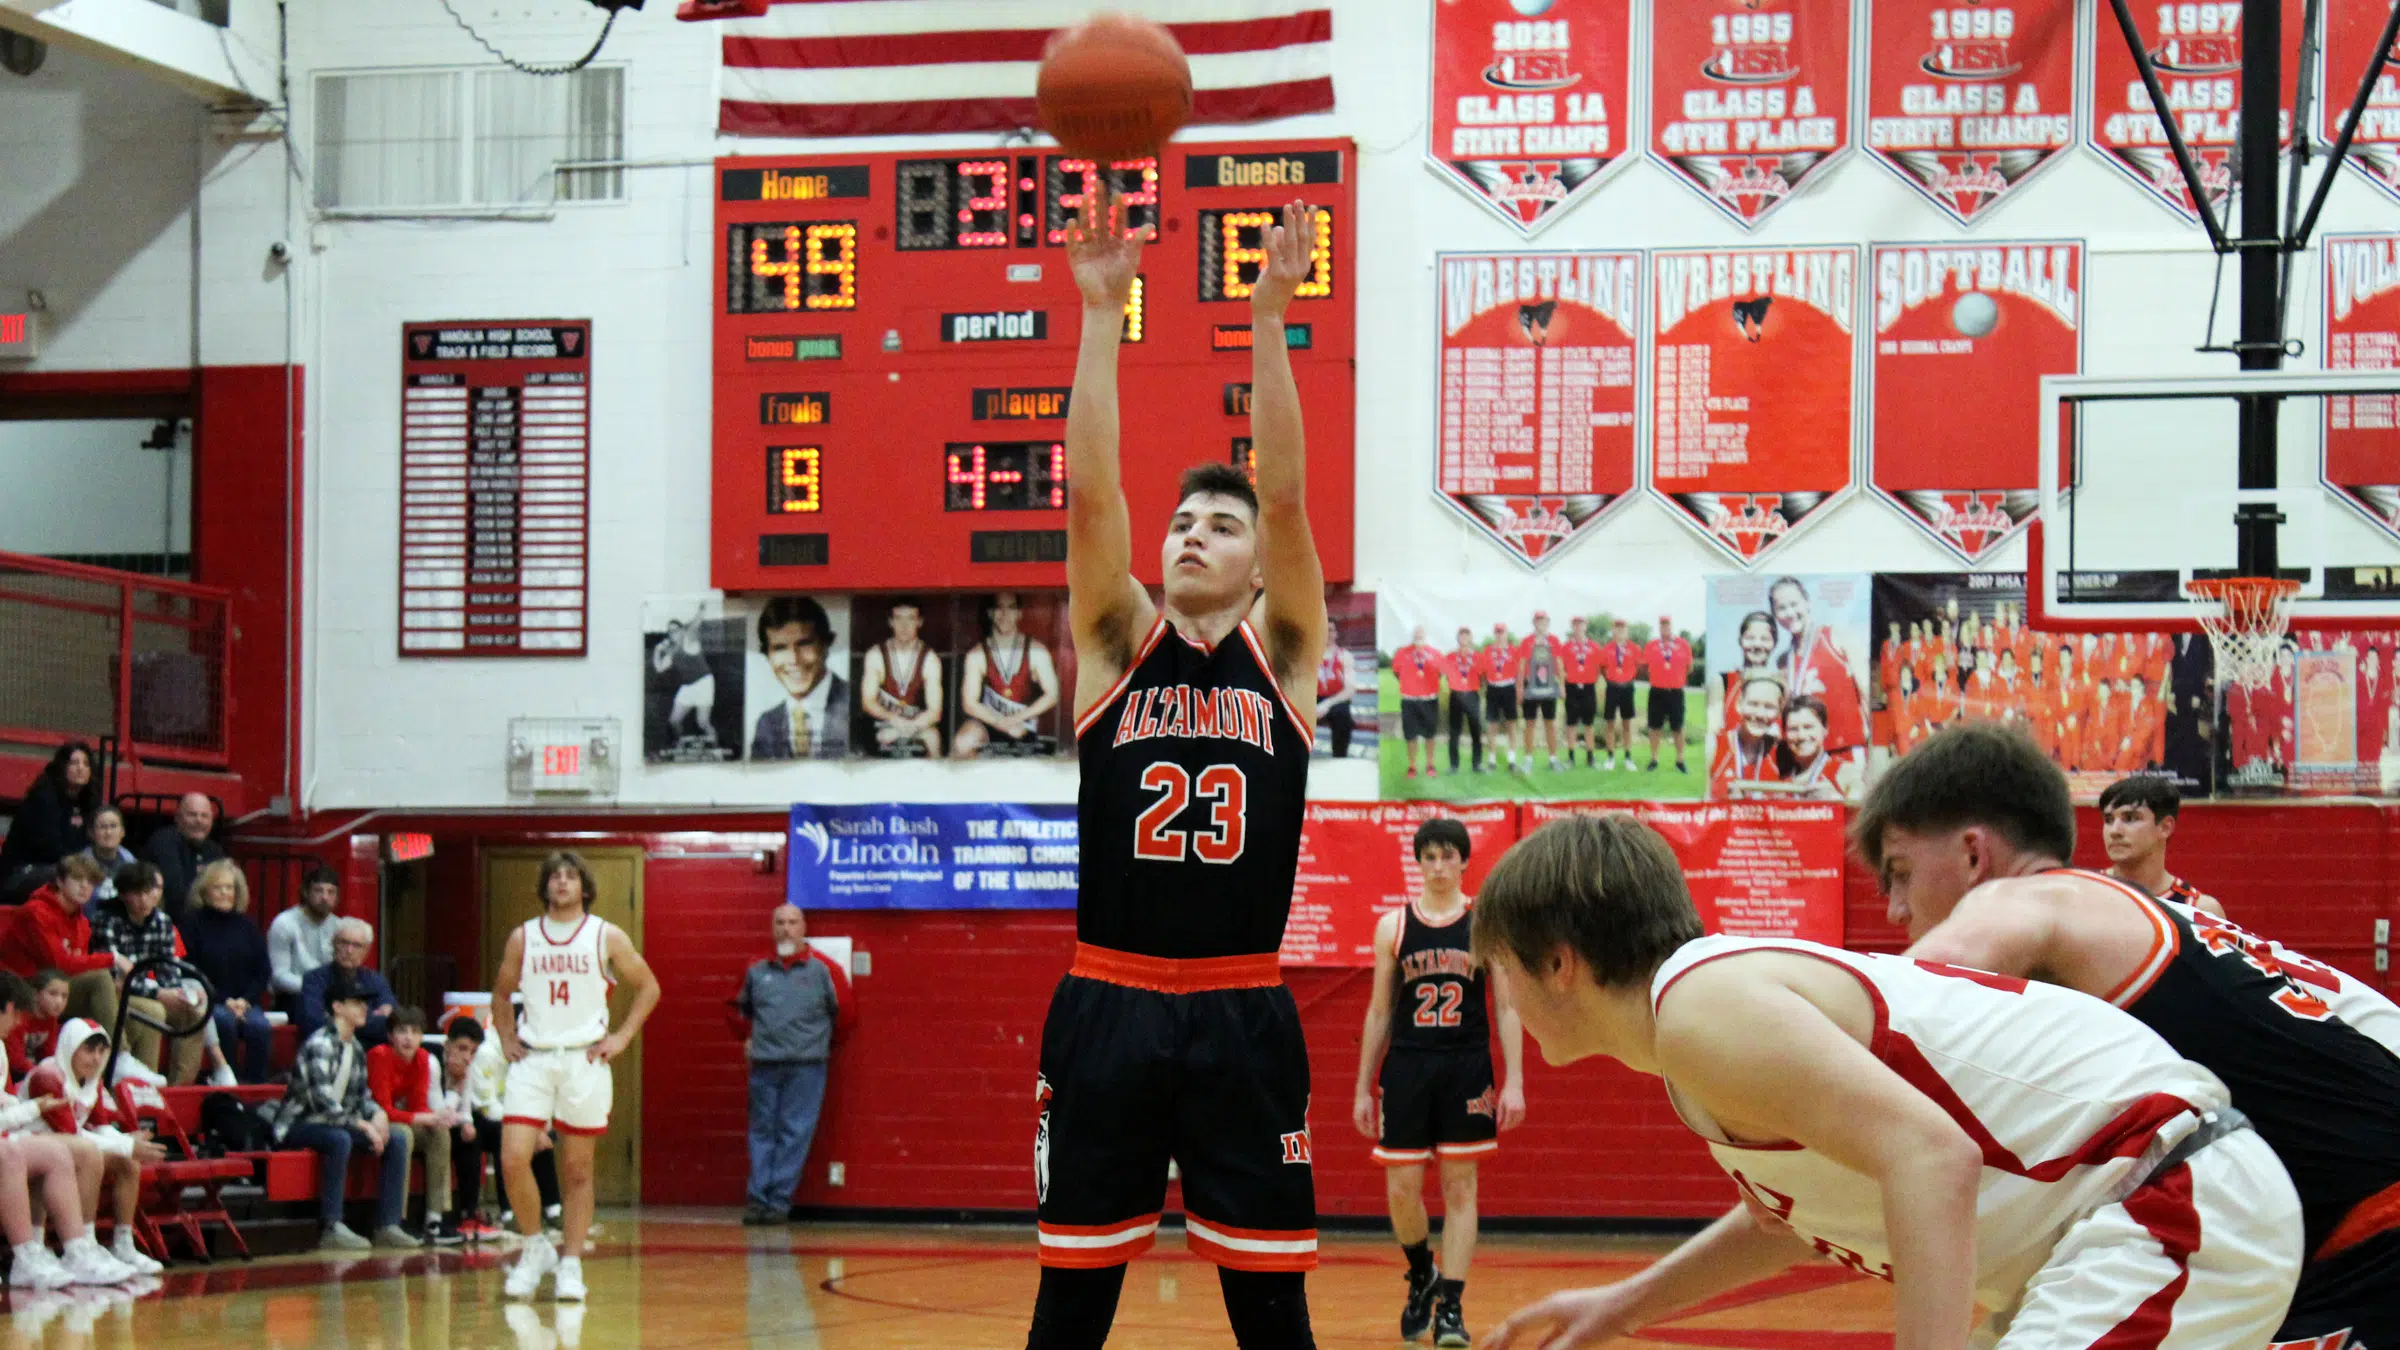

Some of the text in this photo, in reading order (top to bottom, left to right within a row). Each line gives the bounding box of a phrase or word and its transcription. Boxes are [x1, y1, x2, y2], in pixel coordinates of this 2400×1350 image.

[1711, 12, 1794, 46] 1995
[1930, 8, 2014, 40] 1996
[2157, 2, 2242, 34] 1997
[1492, 20, 1570, 51] 2021
[1456, 92, 1608, 125] CLASS 1A
[1682, 84, 1817, 121] CLASS A
[1901, 82, 2041, 115] CLASS A
[1452, 125, 1609, 156] STATE CHAMPS
[1661, 117, 1838, 153] 4TH PLACE
[1869, 113, 2072, 148] STATE CHAMPS
[761, 171, 829, 200] Home
[1217, 156, 1306, 186] Guests
[752, 224, 856, 309] 49
[1445, 257, 1636, 339] WRESTLING
[1658, 253, 1852, 335] WRESTLING
[1877, 247, 2077, 334] SOFTBALL
[0, 313, 27, 344] XIT
[515, 327, 555, 342] SCHOOL
[953, 310, 1035, 343] period
[1213, 327, 1253, 347] bonu
[435, 345, 468, 359] TRACK
[479, 345, 509, 358] FIELD
[511, 343, 558, 358] RECORDS
[748, 338, 795, 358] bonus
[767, 396, 823, 424] fouls
[986, 387, 1065, 421] player
[782, 447, 820, 512] 9
[1112, 684, 1275, 756] ALTAMONT
[543, 745, 581, 776] EXIT
[829, 815, 940, 836] Sarah Bush
[1134, 761, 1247, 866] 23
[966, 819, 1079, 840] THE ATHLETIC
[830, 836, 940, 866] Lincoln
[952, 844, 1079, 866] TRAINING CHOIC
[952, 871, 974, 891] OF
[977, 870, 1010, 891] THE
[531, 954, 589, 975] VANDALS
[548, 979, 570, 1006] 14
[1413, 981, 1464, 1028] 22
